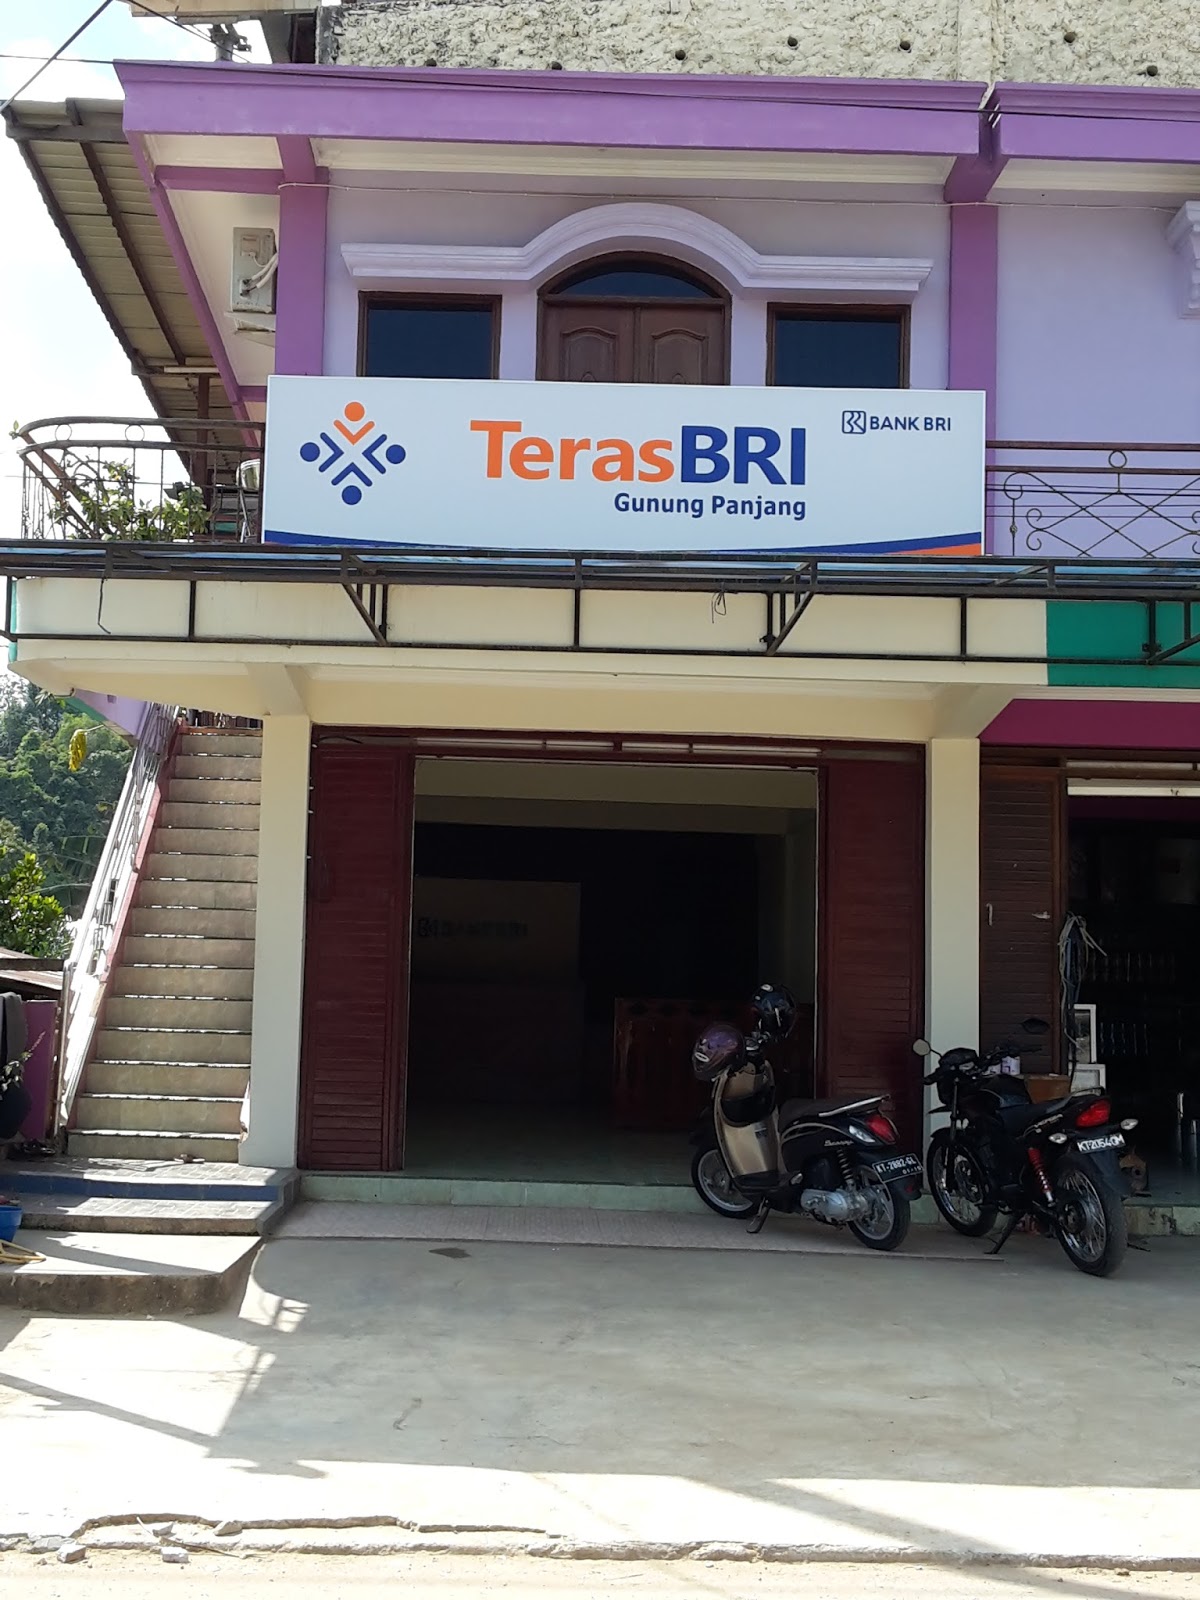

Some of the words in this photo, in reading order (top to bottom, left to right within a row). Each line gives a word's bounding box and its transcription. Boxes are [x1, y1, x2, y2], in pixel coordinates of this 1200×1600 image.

[869, 415, 920, 431] BANK
[923, 416, 952, 432] BRI
[470, 419, 806, 486] TerasBRI
[613, 492, 704, 519] Gunung
[711, 495, 806, 521] Panjang
